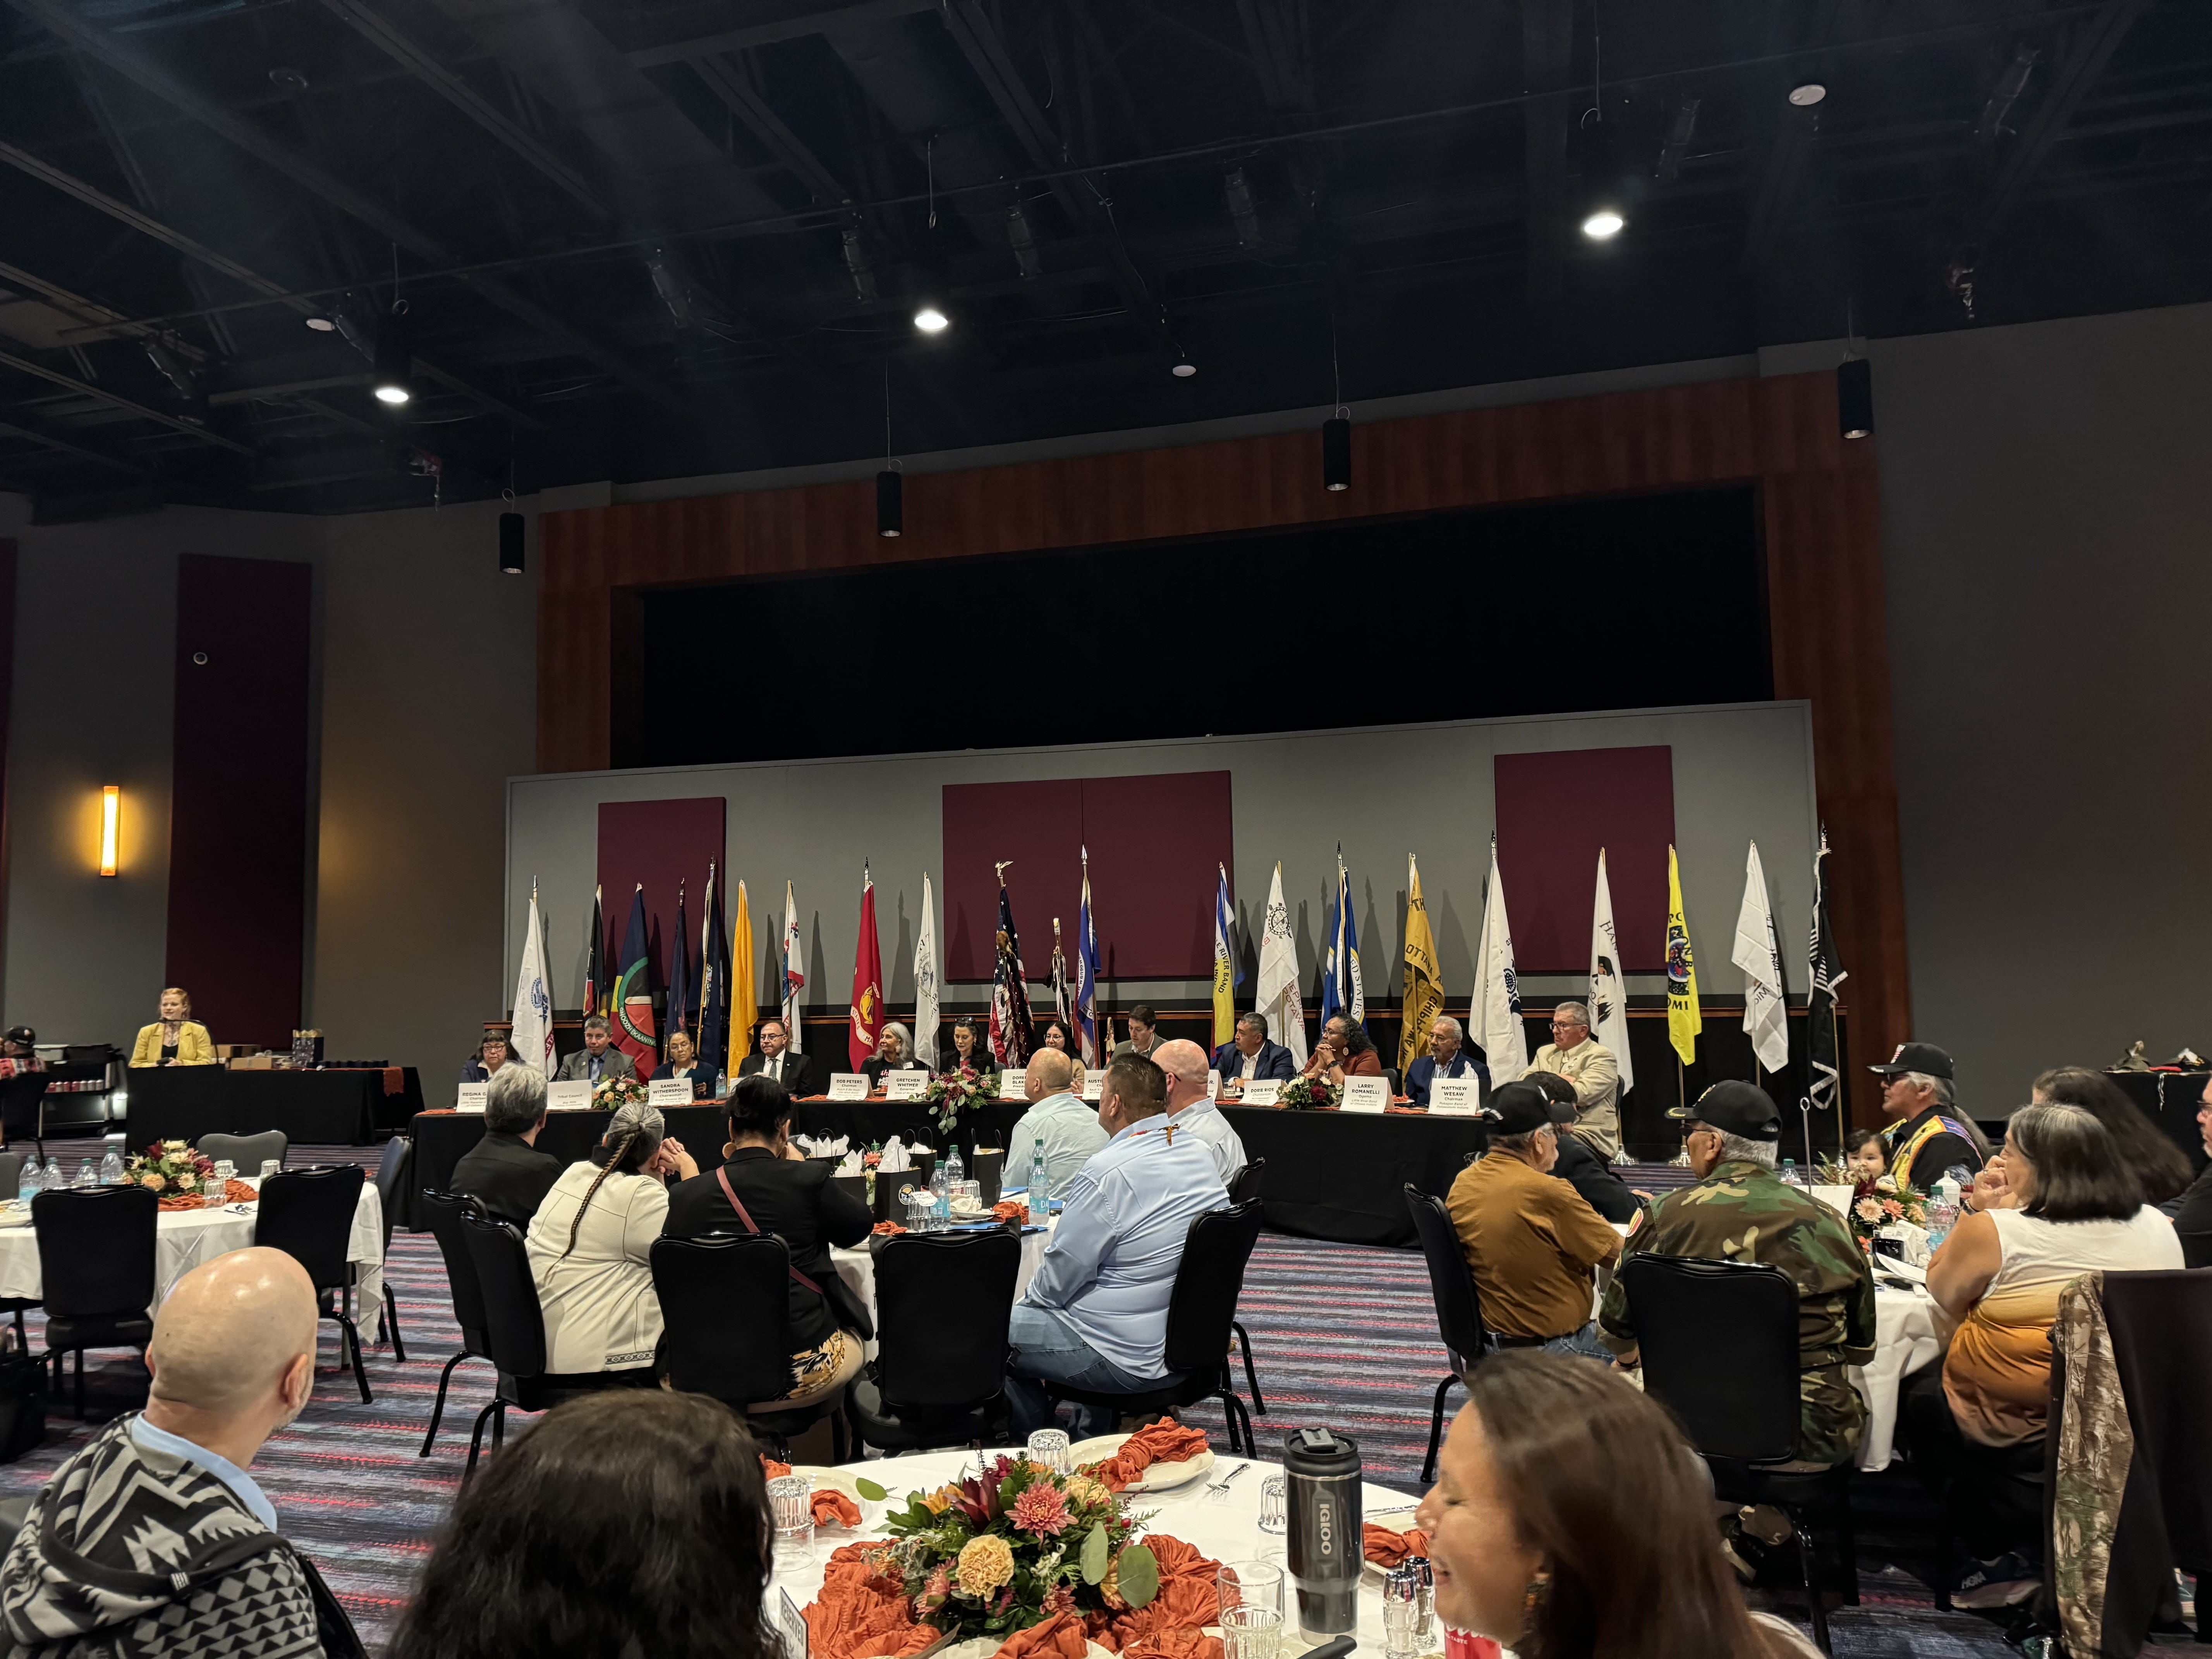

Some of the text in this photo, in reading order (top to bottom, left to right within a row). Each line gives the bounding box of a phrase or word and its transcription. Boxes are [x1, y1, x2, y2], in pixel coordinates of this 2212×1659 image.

[1218, 948, 1229, 993] RIVER BAND
[1406, 944, 1433, 976] OTTAWA
[1352, 975, 1363, 1016] STATES
[1319, 1503, 1332, 1556] IGLOO
[1961, 1571, 1986, 1589] HOKA
[1451, 1636, 1468, 1645] TASTE
